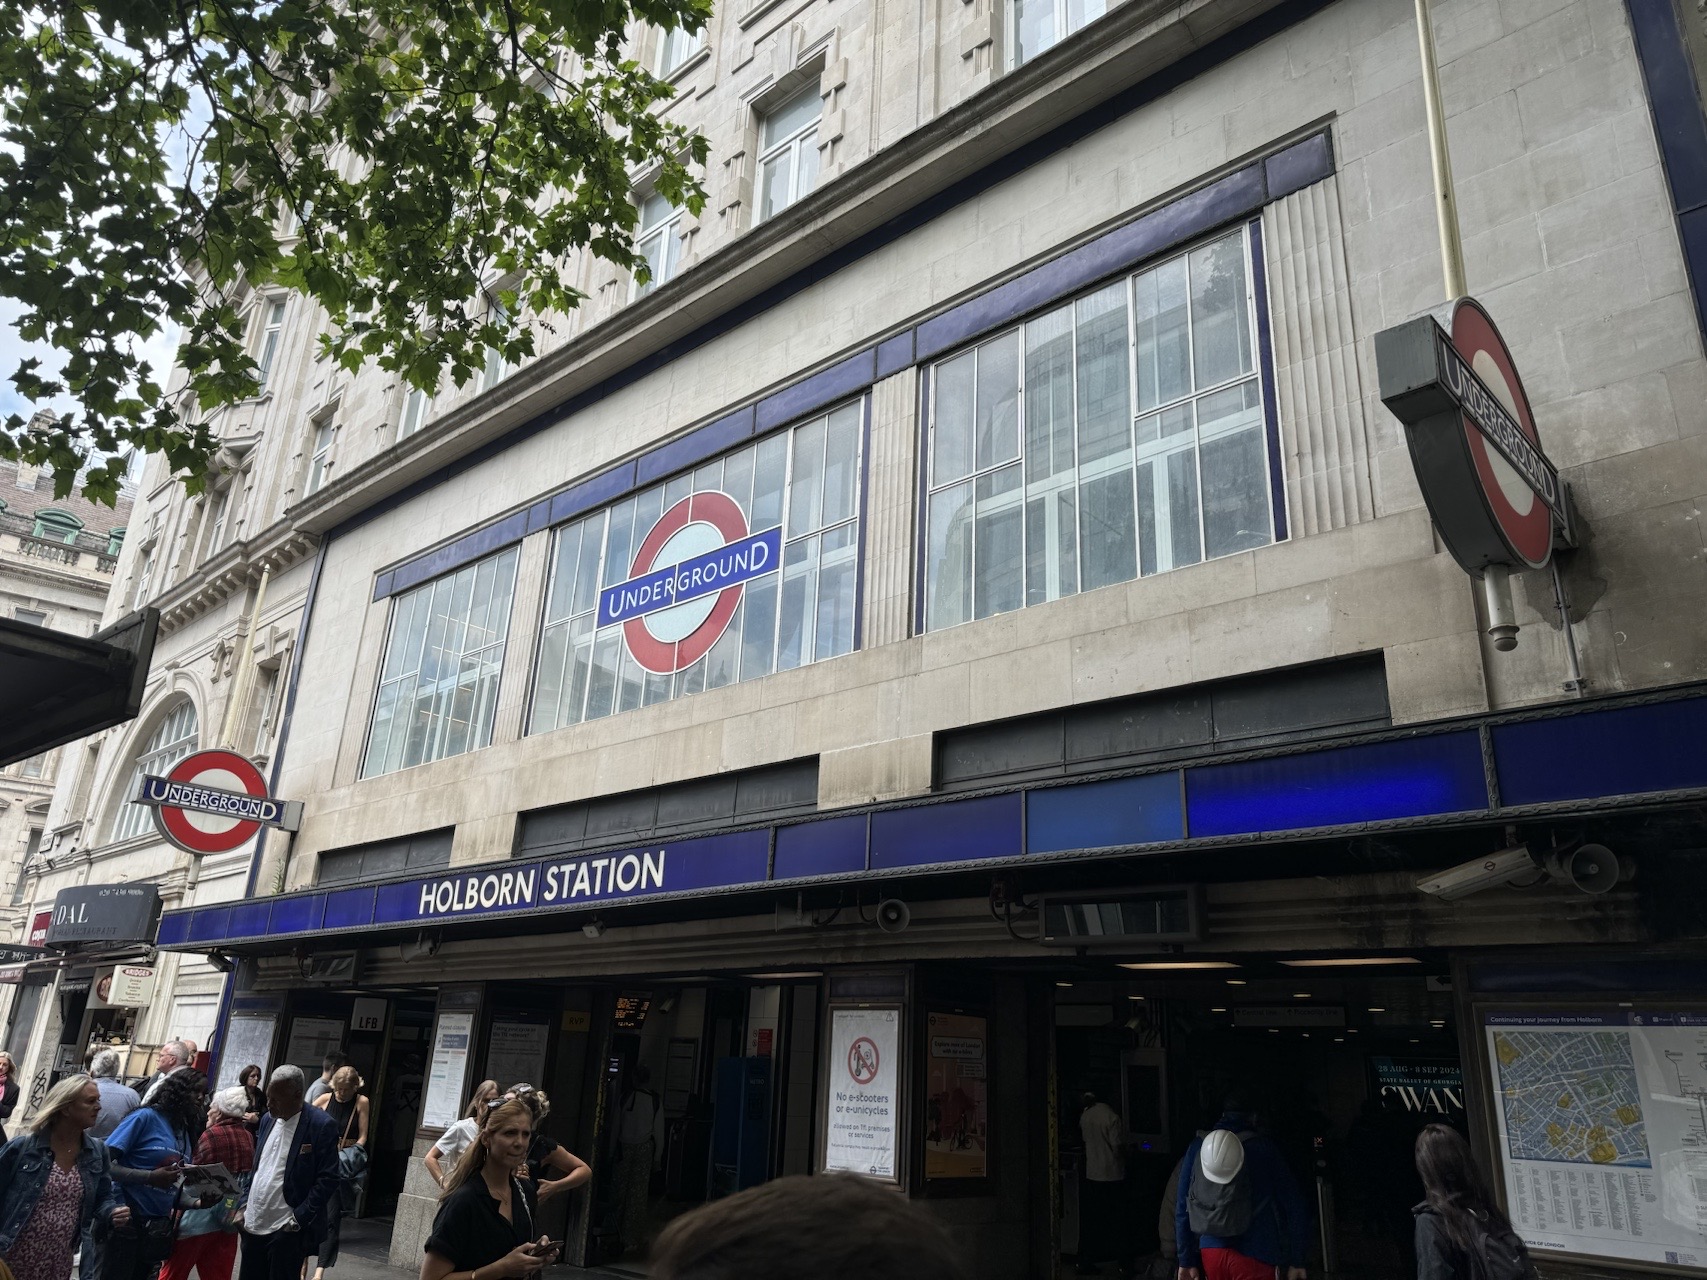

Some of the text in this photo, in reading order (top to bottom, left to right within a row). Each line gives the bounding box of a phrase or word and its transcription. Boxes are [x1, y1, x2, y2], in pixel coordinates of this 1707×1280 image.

[1443, 342, 1556, 504] UNDERGROUND
[609, 541, 769, 618] UNDERGROUND
[150, 780, 276, 820] UNDERGROUND
[418, 850, 665, 914] HOLBORN STATION
[358, 1016, 378, 1029] LFB
[1490, 1016, 1522, 1024] Continuing
[1537, 1016, 1560, 1024] journey
[1377, 1065, 1389, 1073] 28
[1389, 1065, 1408, 1073] AUG
[1414, 1065, 1421, 1073] 8
[1421, 1066, 1438, 1074] SEP
[1439, 1066, 1460, 1075] 2024
[836, 1091, 889, 1104] No e-scooters
[835, 1105, 889, 1117] or e-unicycles
[867, 1125, 891, 1133] premises
